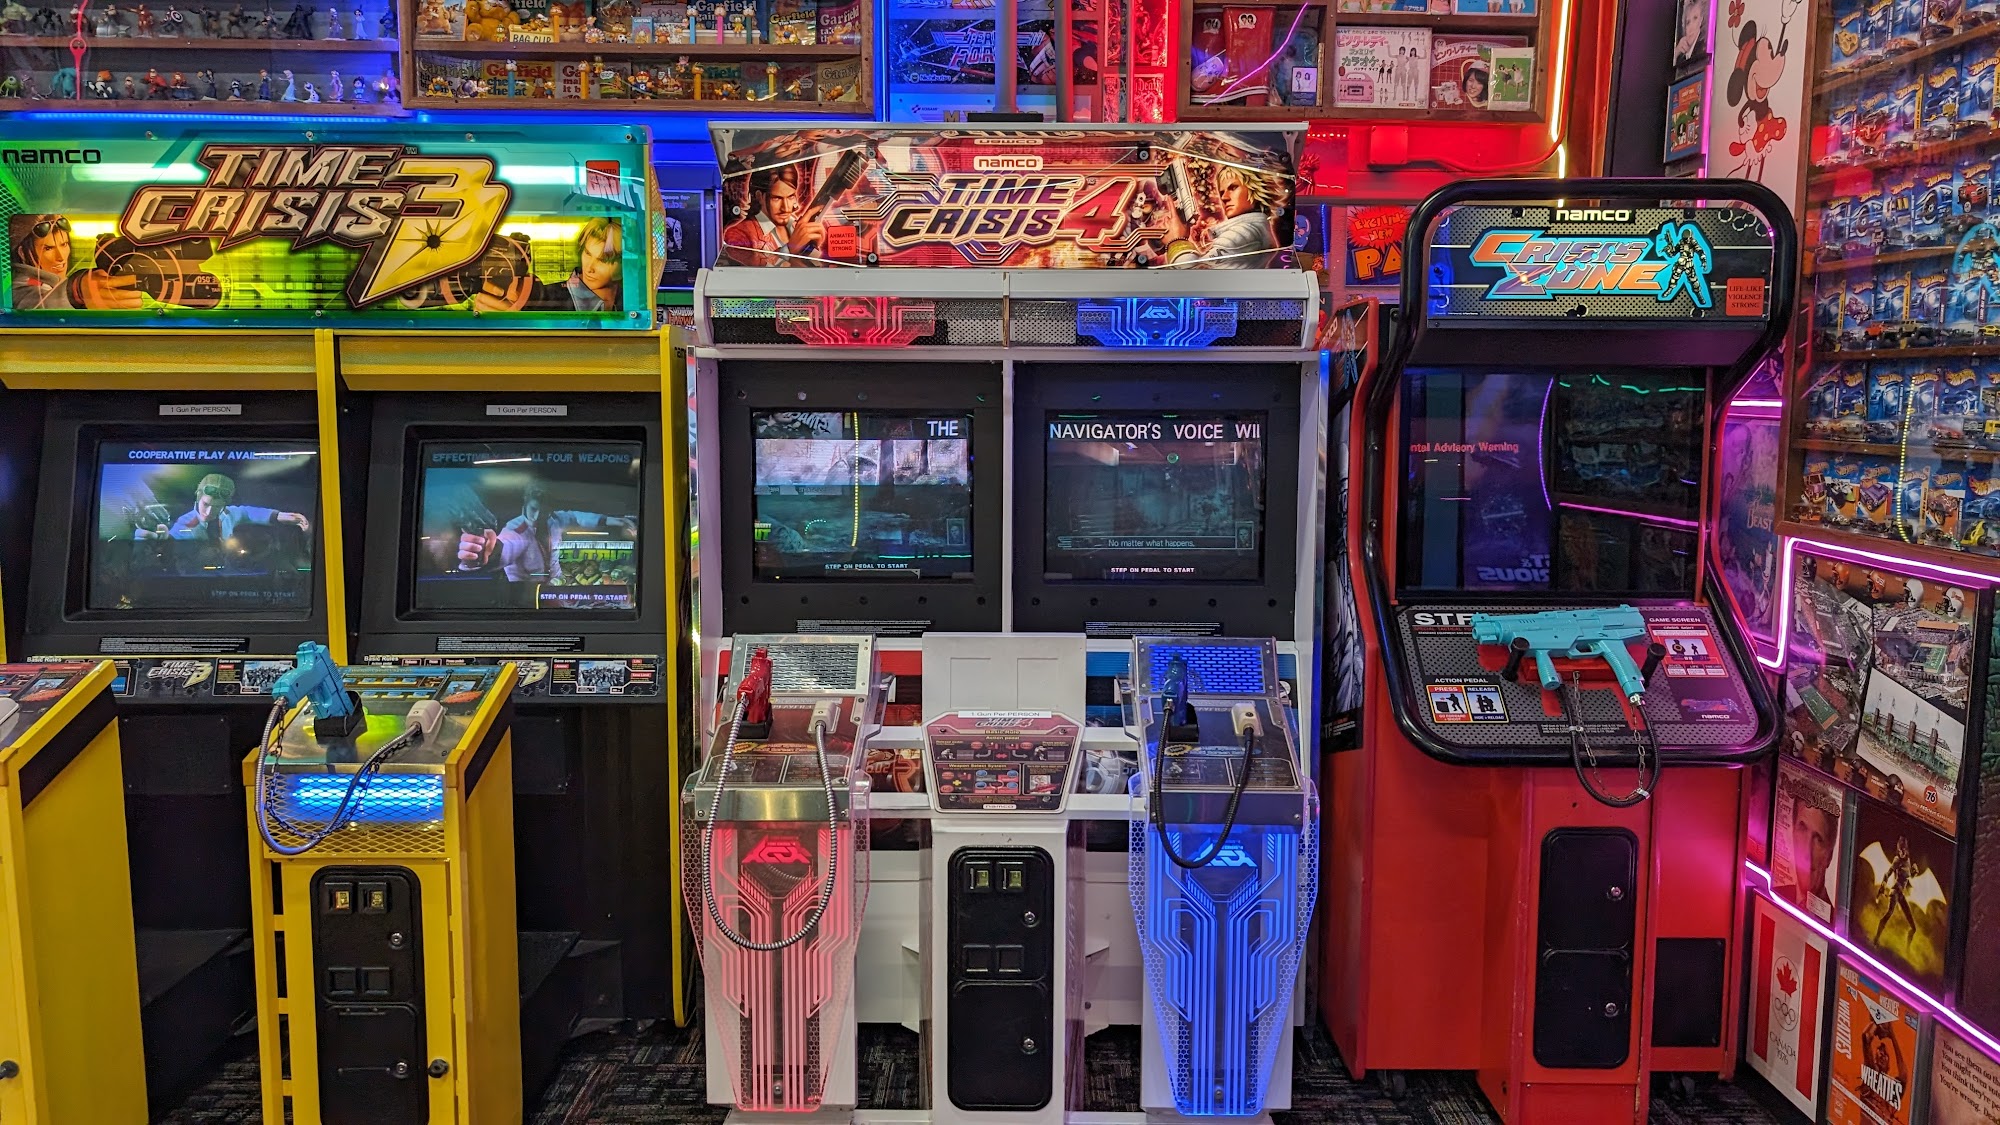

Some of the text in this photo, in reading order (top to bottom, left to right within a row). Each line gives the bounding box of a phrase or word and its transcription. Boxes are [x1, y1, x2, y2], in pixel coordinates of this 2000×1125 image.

[770, 9, 816, 24] Garfield
[820, 5, 860, 25] Garfield
[513, 34, 531, 43] BAG
[487, 63, 551, 78] Gafield
[1, 149, 102, 164] namco
[979, 158, 1039, 168] namco
[205, 147, 402, 187] TIME
[944, 177, 1077, 205] TIME
[127, 188, 404, 248] CRISIS
[887, 178, 1133, 244] CRISIS 4
[1556, 210, 1631, 222] namco
[350, 157, 511, 306] 3
[1369, 228, 1393, 242] NEW
[1473, 233, 1648, 264] CRISIS
[1493, 264, 1668, 295] ZONE
[927, 420, 959, 437] THE
[1050, 423, 1161, 439] NAVIGATOR'S
[1173, 424, 1224, 439] VOICE
[128, 451, 225, 460] COOPERATIVE PLAY
[547, 453, 630, 462] FOUR WEAPONS
[1433, 442, 1519, 454] Advisory Warning
[1108, 539, 1119, 547] No
[1146, 539, 1163, 547] what
[162, 660, 196, 668] TIME
[148, 661, 214, 688] CRISIS 3
[1925, 791, 1937, 804] 76
[1879, 995, 1900, 1017] WHEATIES
[1836, 998, 1852, 1060] WHEATIES
[1769, 1032, 1796, 1061] CANADA
[1777, 1050, 1789, 1066] 1976
[1943, 1040, 1954, 1054] You
[1955, 1050, 1966, 1062] see
[1966, 1057, 1982, 1074] them
[1941, 1061, 1952, 1076] You
[1952, 1071, 1968, 1088] think
[1942, 1050, 1953, 1064] You
[1954, 1061, 1971, 1078] might
[1972, 1074, 1987, 1089] even
[1861, 1064, 1903, 1112] WHEATIES
[1939, 1074, 1981, 1113] You're wrong.
